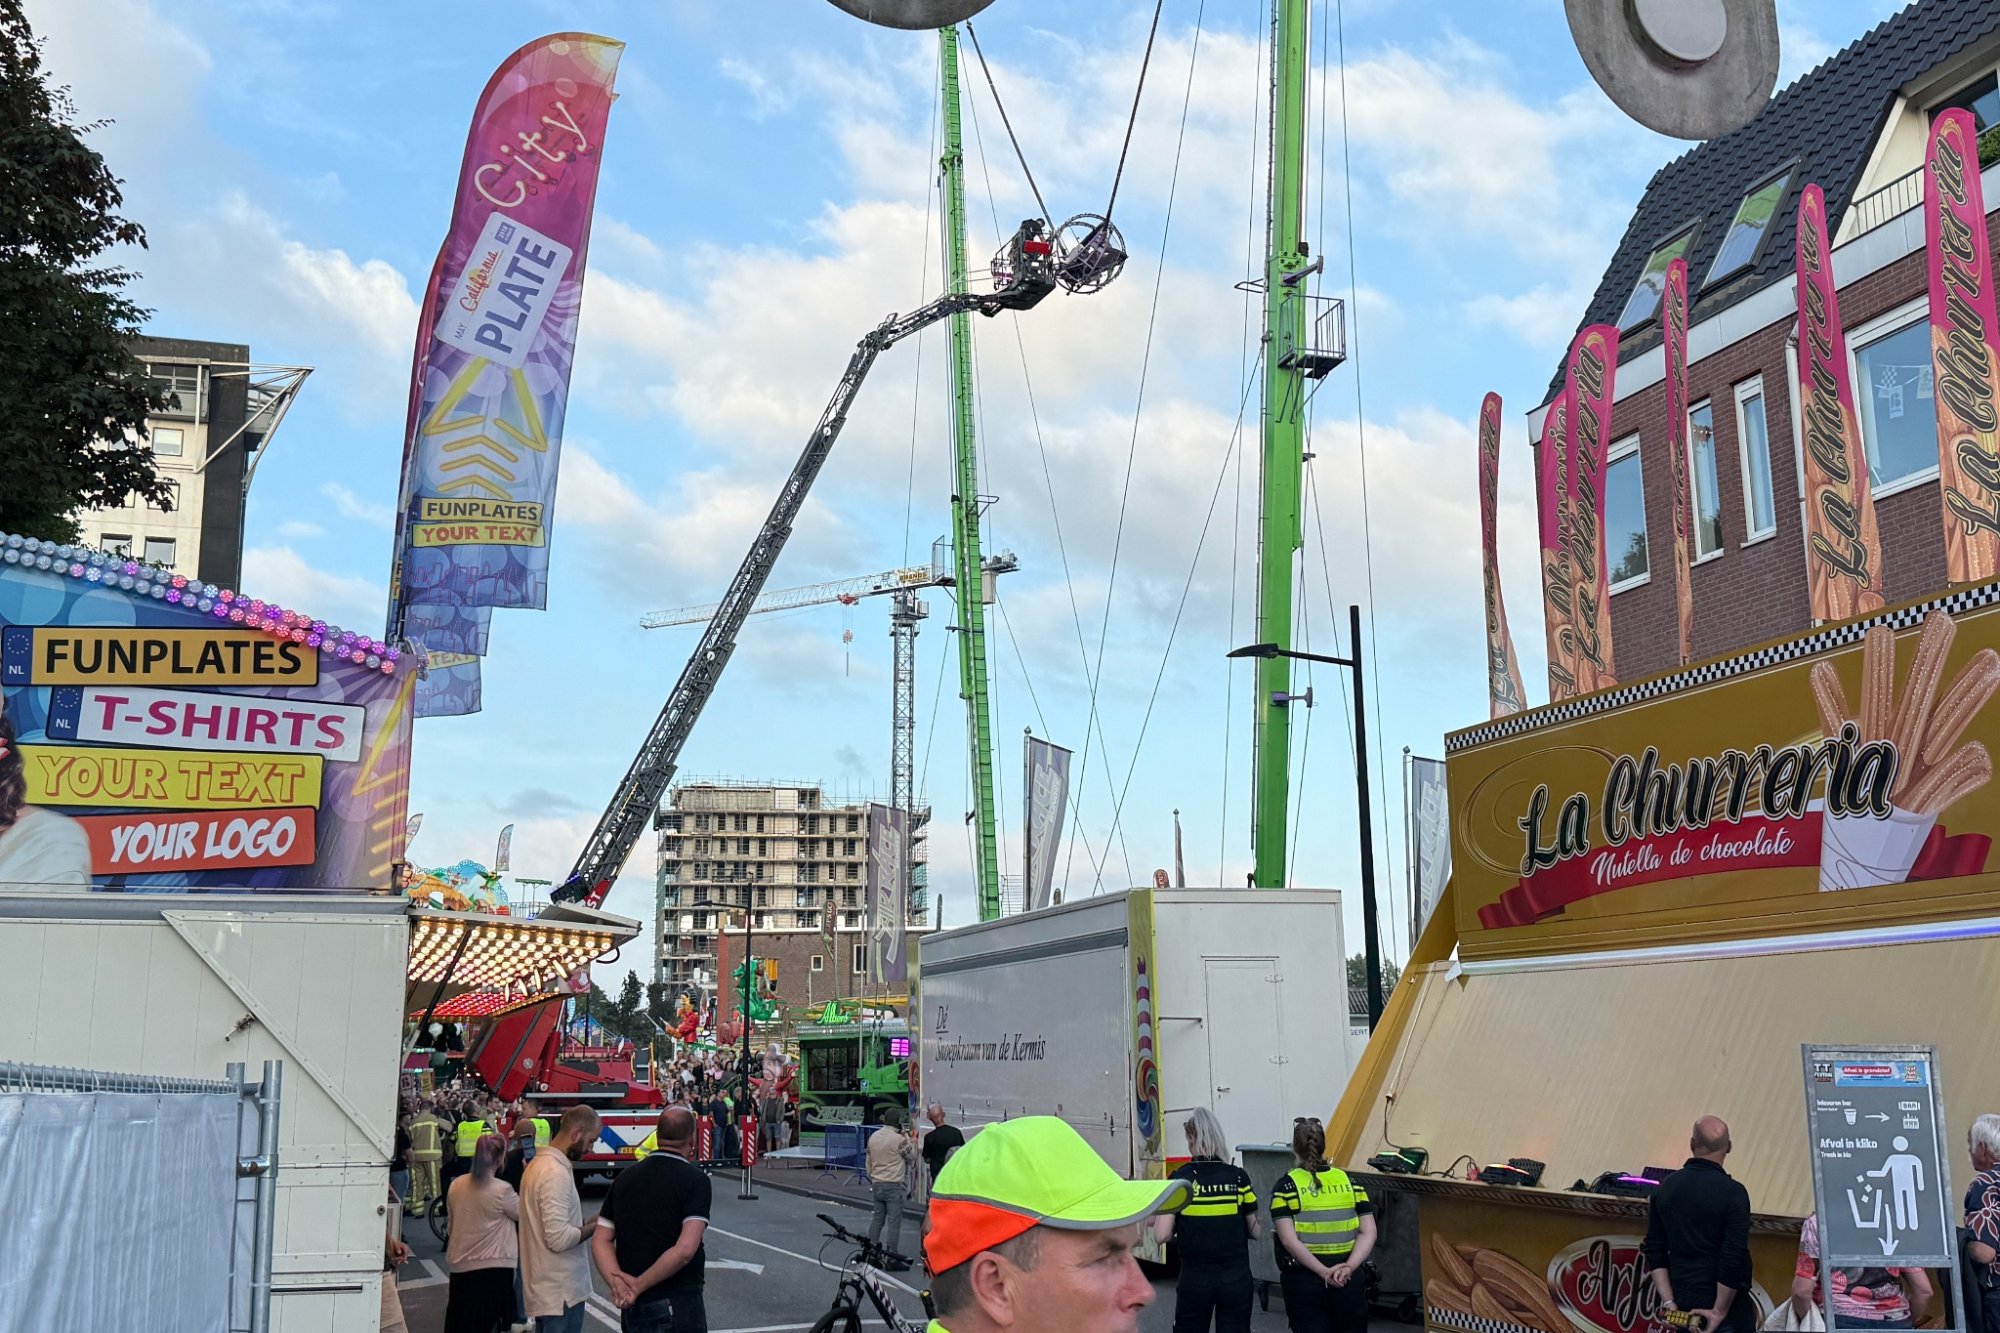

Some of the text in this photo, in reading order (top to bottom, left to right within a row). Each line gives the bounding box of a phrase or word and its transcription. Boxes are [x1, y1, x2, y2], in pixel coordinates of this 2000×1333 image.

[475, 101, 587, 208] City
[459, 250, 499, 312] California
[474, 236, 557, 354] PLATE
[1929, 131, 2000, 539] La Churreria
[421, 524, 538, 543] YOUR TEXT
[427, 502, 538, 521] FUNPLATES
[1568, 342, 1605, 675] La Churreria
[1811, 487, 1872, 592] La
[8, 639, 302, 675] NL FUNPLATES
[431, 652, 470, 667] TEX
[55, 694, 346, 750] NL T-SHIRTS
[37, 755, 306, 803] YOUR TEXT
[1517, 719, 1899, 878] La Churreria
[109, 815, 297, 865] YOUR LOGO
[1590, 826, 1796, 886] Nutella de chocolate
[935, 1003, 949, 1030] Dé
[982, 1042, 997, 1061] van
[998, 1032, 1011, 1061] de
[1011, 1033, 1046, 1061] Kermis
[1813, 1063, 1831, 1072] TT
[1820, 1138, 1878, 1149] Afval in kliko
